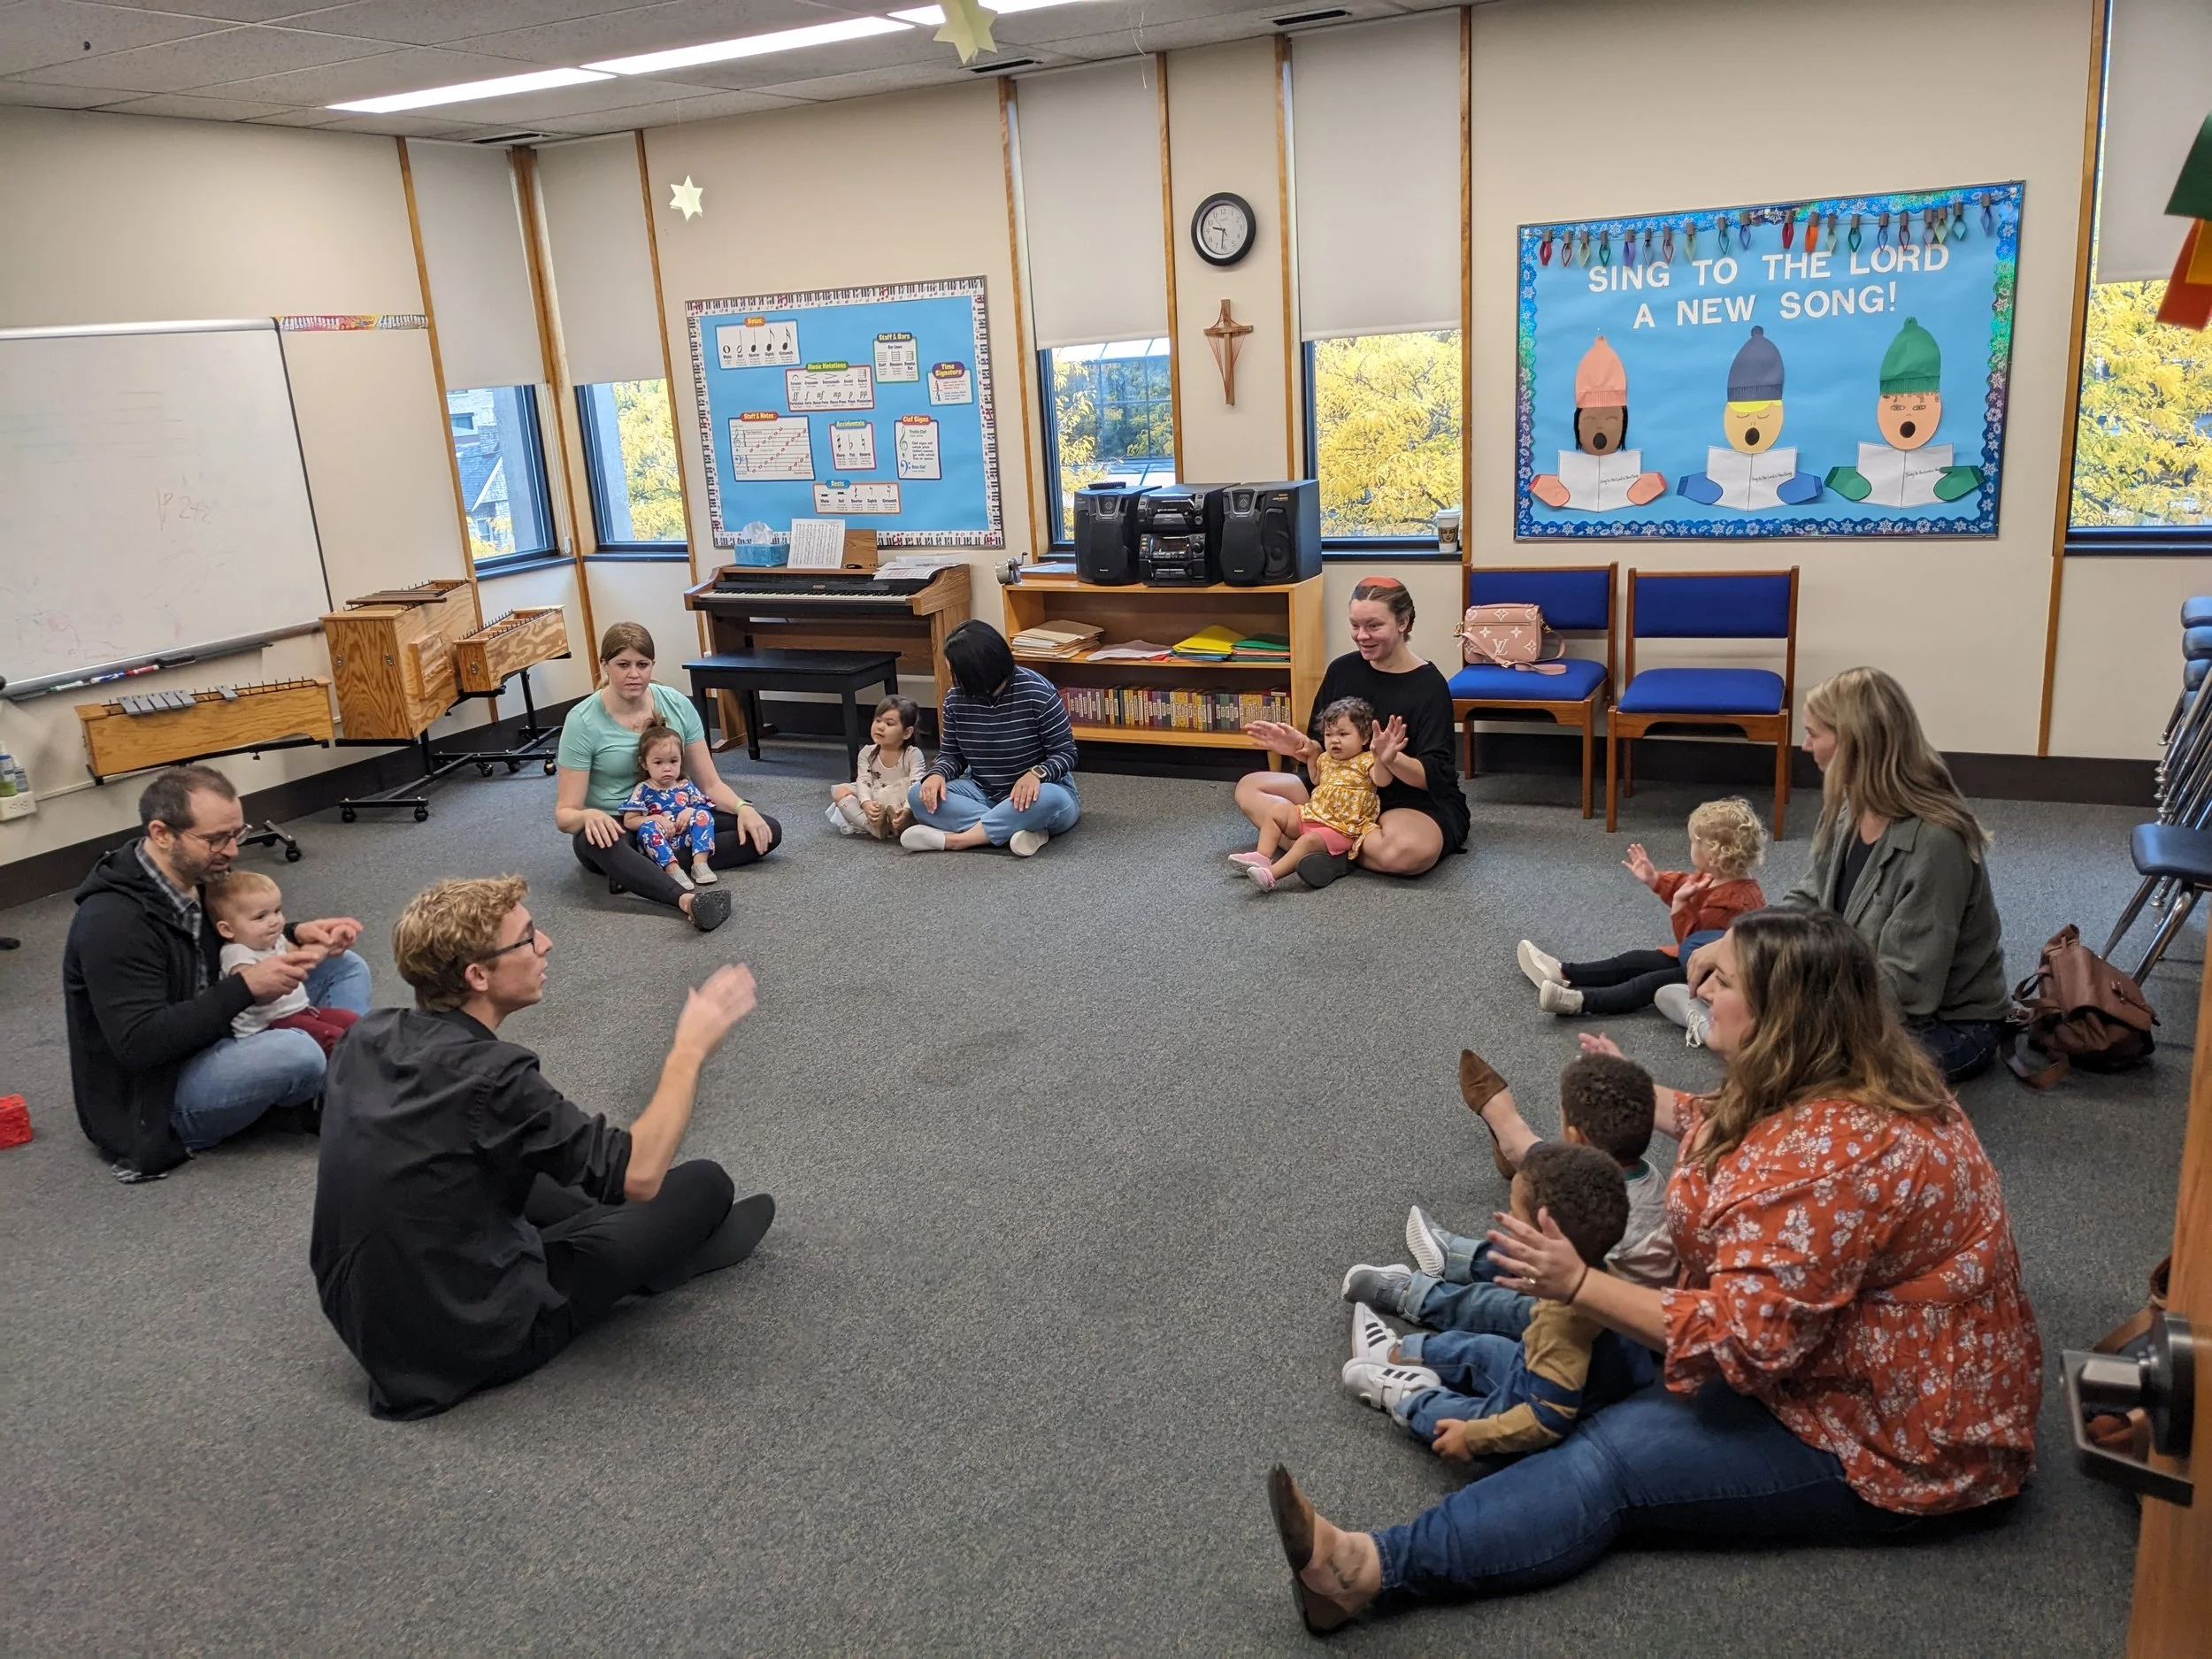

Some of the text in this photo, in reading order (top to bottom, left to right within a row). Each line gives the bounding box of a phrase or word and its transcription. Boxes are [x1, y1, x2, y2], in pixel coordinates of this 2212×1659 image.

[1588, 243, 1949, 293] SING TO THE LORD
[1633, 281, 1896, 329] A NEW SONG!
